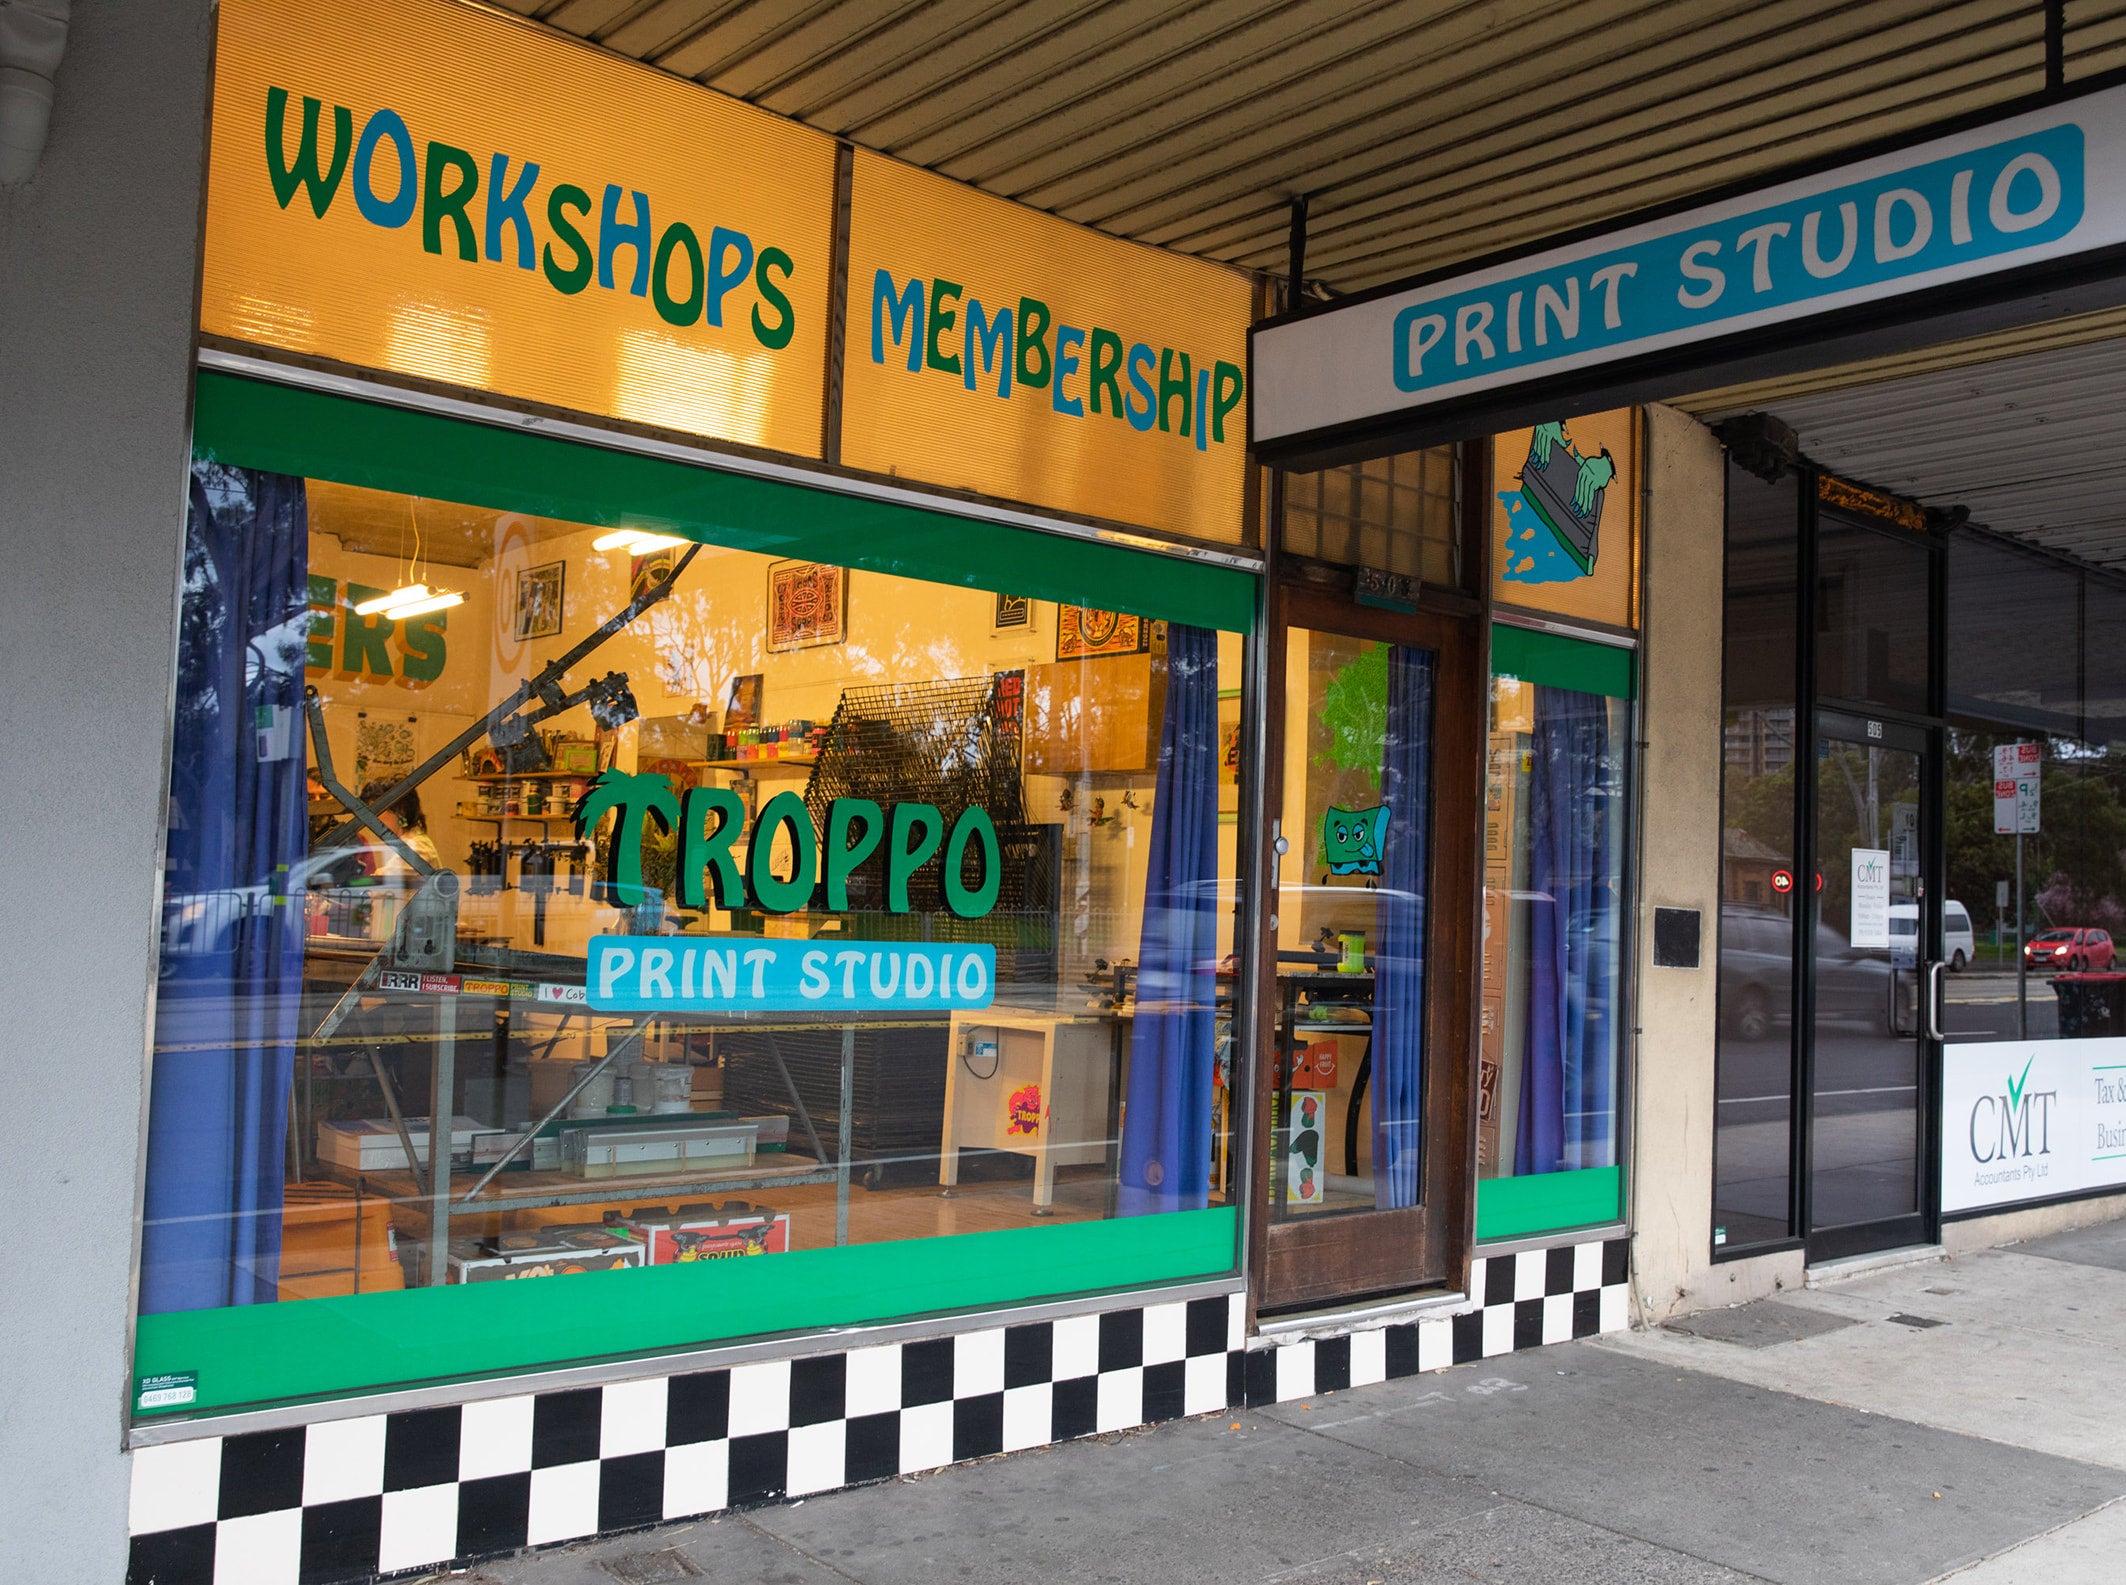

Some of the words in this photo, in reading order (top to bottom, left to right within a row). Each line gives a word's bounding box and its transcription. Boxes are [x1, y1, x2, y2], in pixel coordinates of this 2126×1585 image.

[265, 85, 795, 350] WORKSHOPS
[1407, 262, 1638, 378] PRINT
[1677, 152, 2062, 309] STUDIO
[871, 269, 1243, 451] MEMBERSHIP
[1868, 722, 1882, 738] 505
[570, 767, 1001, 919] TROPPO
[1857, 863, 1884, 883] CMT
[465, 982, 509, 995] TROPPO
[600, 947, 777, 999] PRINT
[800, 950, 988, 999] STUDIO
[2095, 1078, 2115, 1105] Tax
[1970, 1089, 2058, 1164] CMT
[1974, 1168, 2022, 1187] Accountants
[2023, 1165, 2035, 1182] Pty
[2036, 1163, 2049, 1178] Ltd
